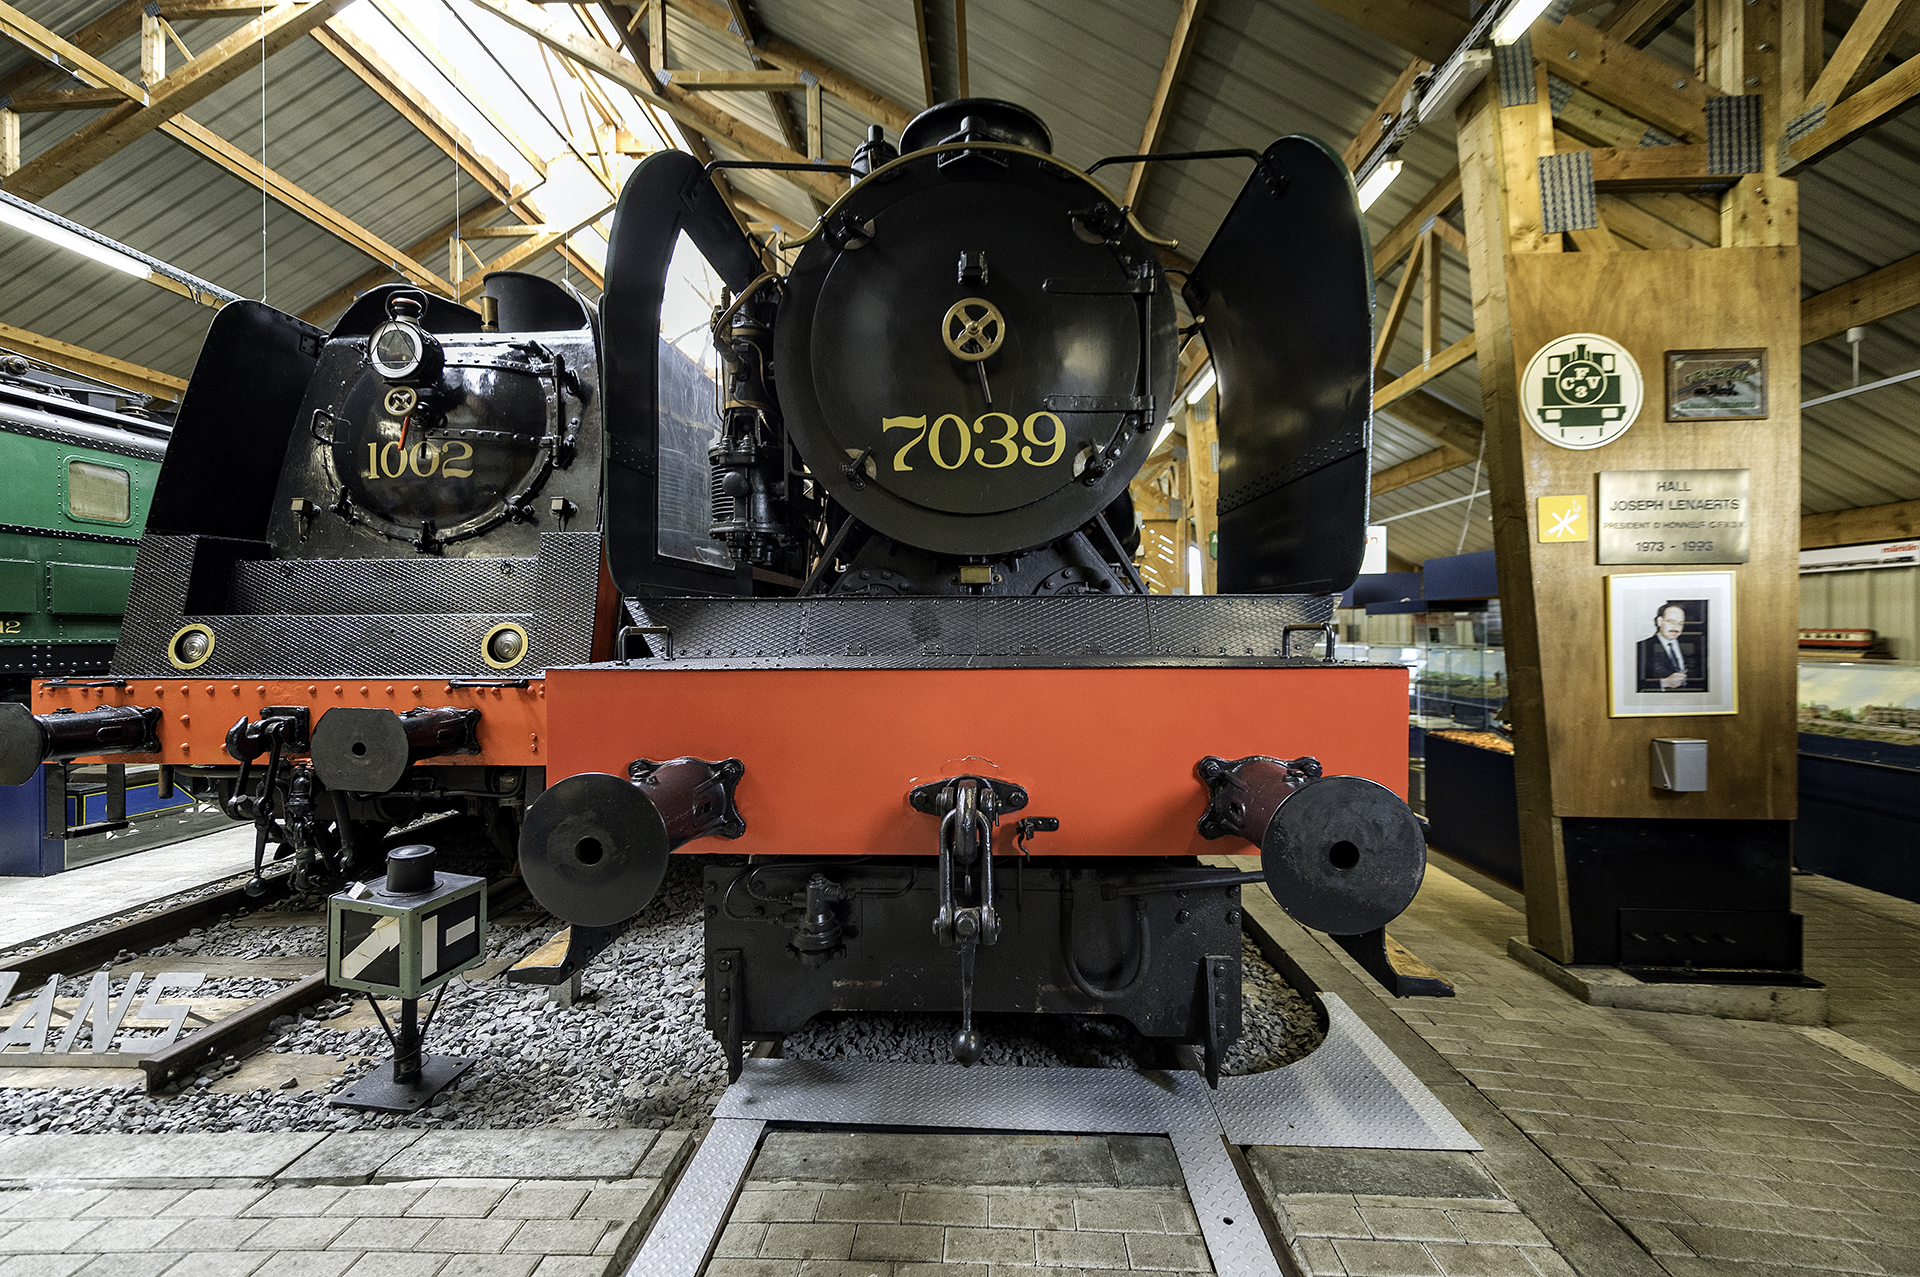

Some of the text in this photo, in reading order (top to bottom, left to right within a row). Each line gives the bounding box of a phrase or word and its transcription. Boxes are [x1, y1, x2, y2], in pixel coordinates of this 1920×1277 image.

[882, 411, 1067, 471] 7039
[368, 441, 474, 479] 1002
[1656, 481, 1692, 492] HALL
[1610, 499, 1740, 511] JOSEPH LENAERTS
[1603, 521, 1650, 529] PRESIDENT
[1636, 541, 1665, 552] 1973
[1682, 541, 1714, 552] 1993
